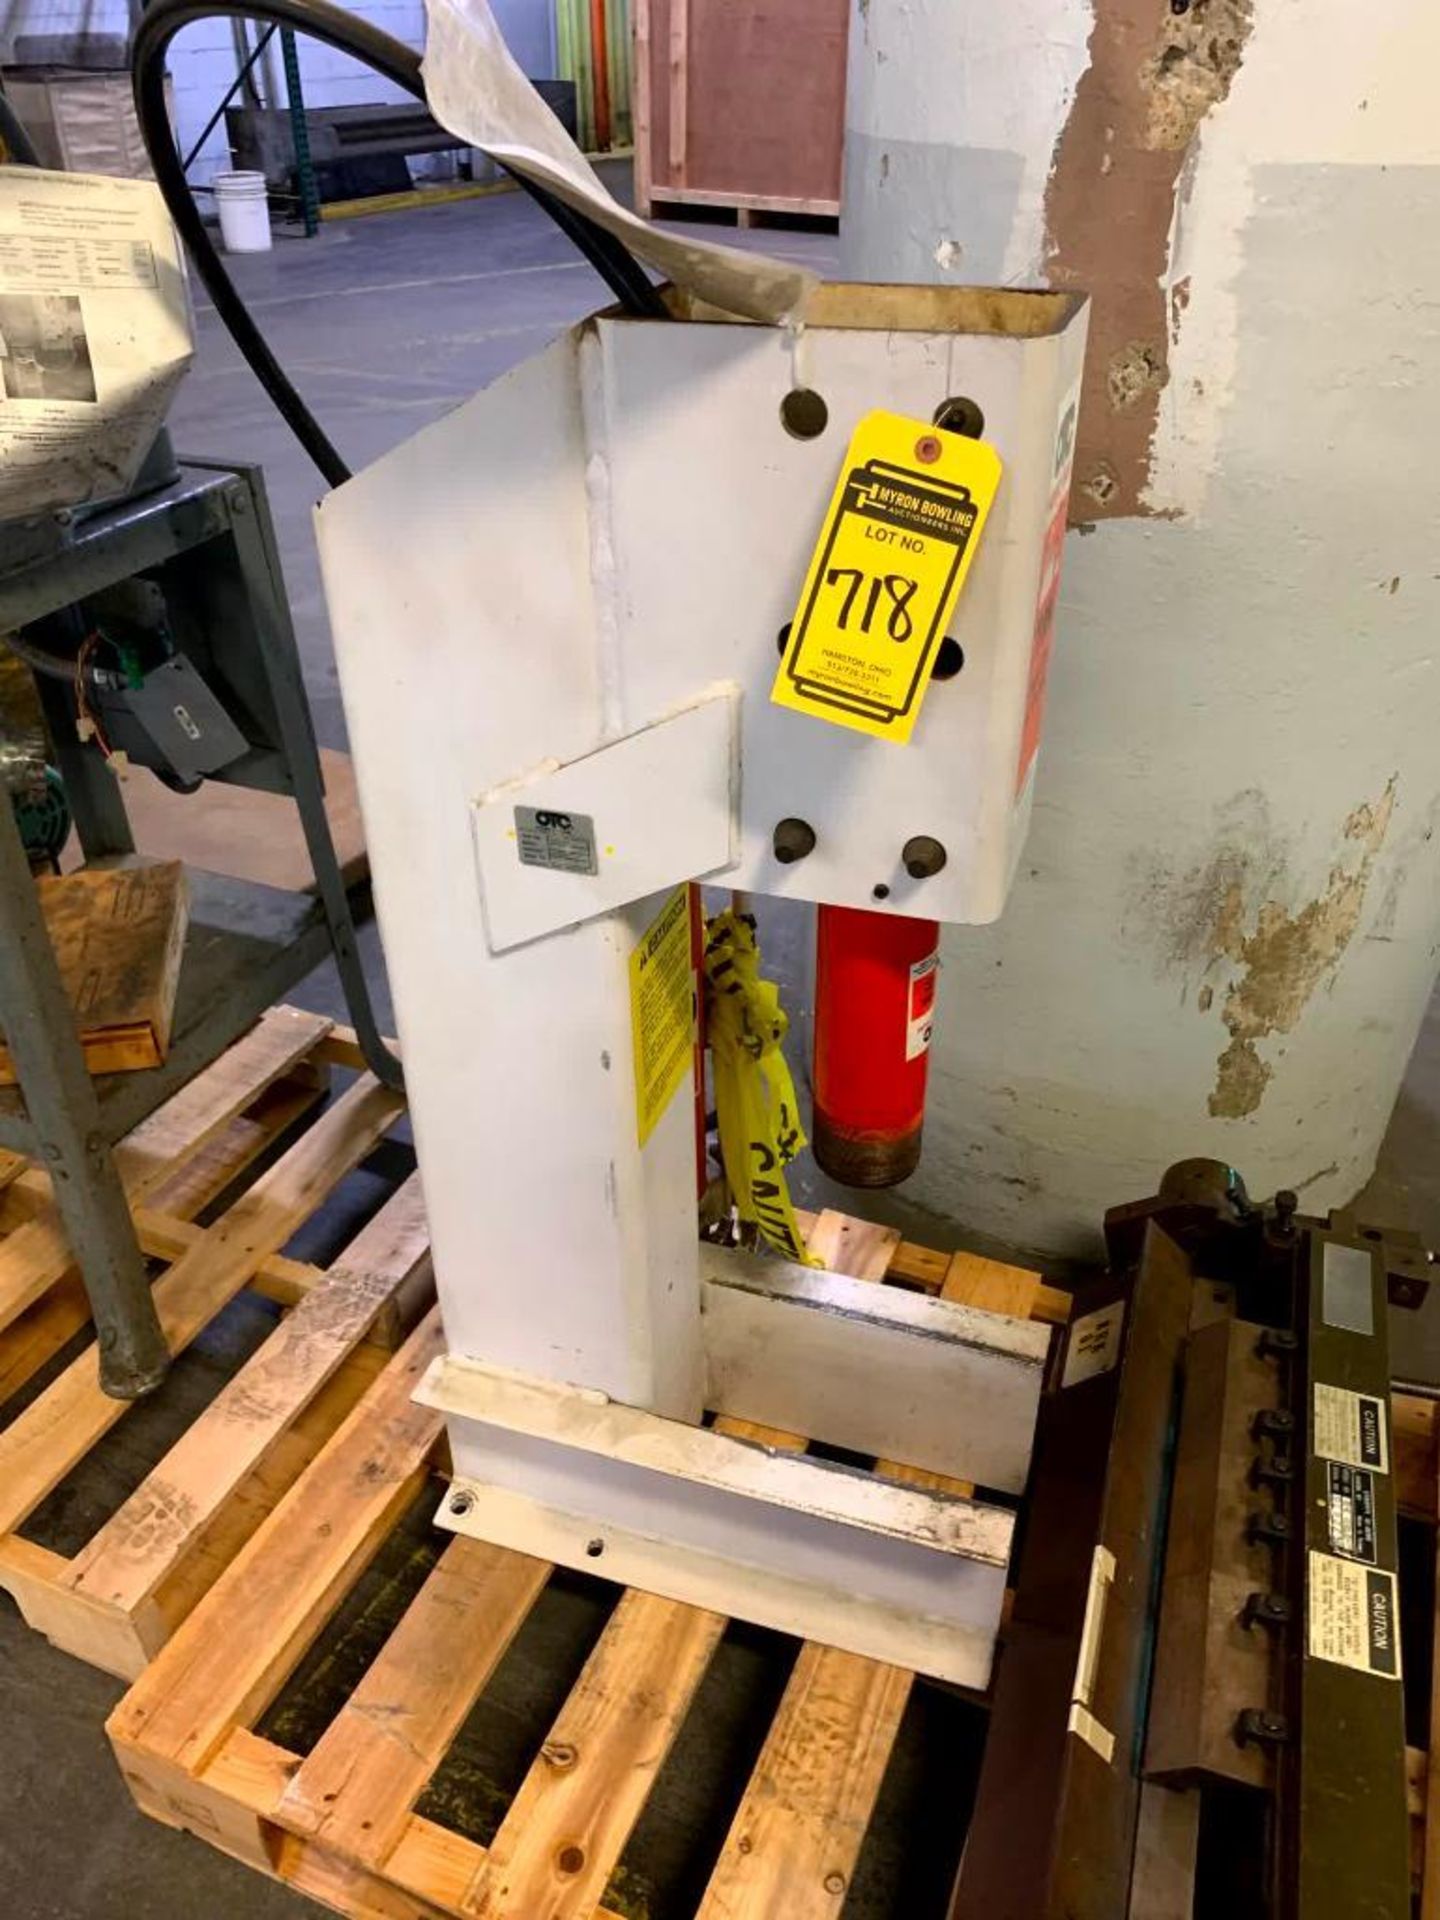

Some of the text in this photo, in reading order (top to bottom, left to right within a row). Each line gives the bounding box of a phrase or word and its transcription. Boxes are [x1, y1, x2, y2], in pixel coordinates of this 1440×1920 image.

[878, 487, 973, 528] MYRON BOWLING
[865, 525, 926, 555] LOT NO.
[827, 568, 918, 643] 718
[1364, 1410, 1377, 1455] CAUTION
[1372, 1593, 1389, 1650] CAUTION
